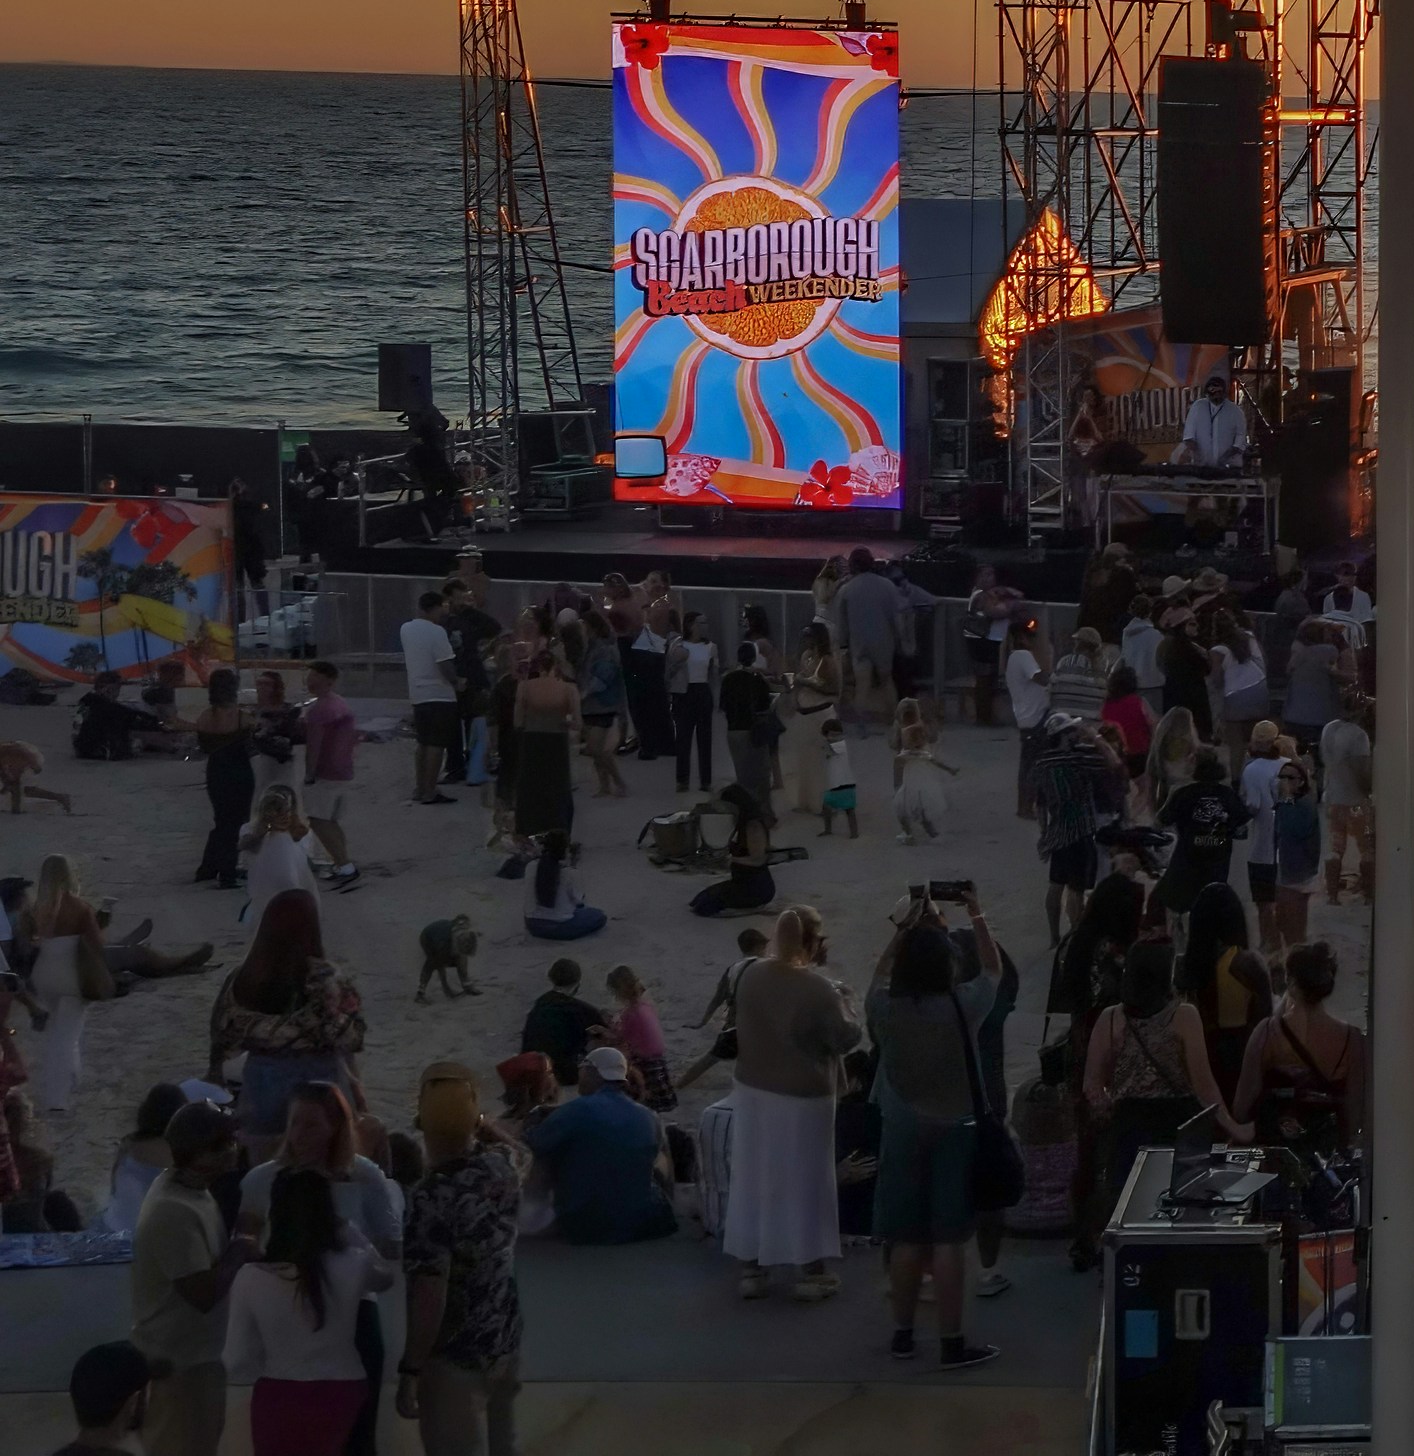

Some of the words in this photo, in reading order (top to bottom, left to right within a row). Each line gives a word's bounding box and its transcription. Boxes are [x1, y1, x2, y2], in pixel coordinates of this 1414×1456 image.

[635, 217, 880, 291] SCARBOROUGH
[646, 279, 748, 315] Beach
[749, 274, 883, 303] WEEKENDER
